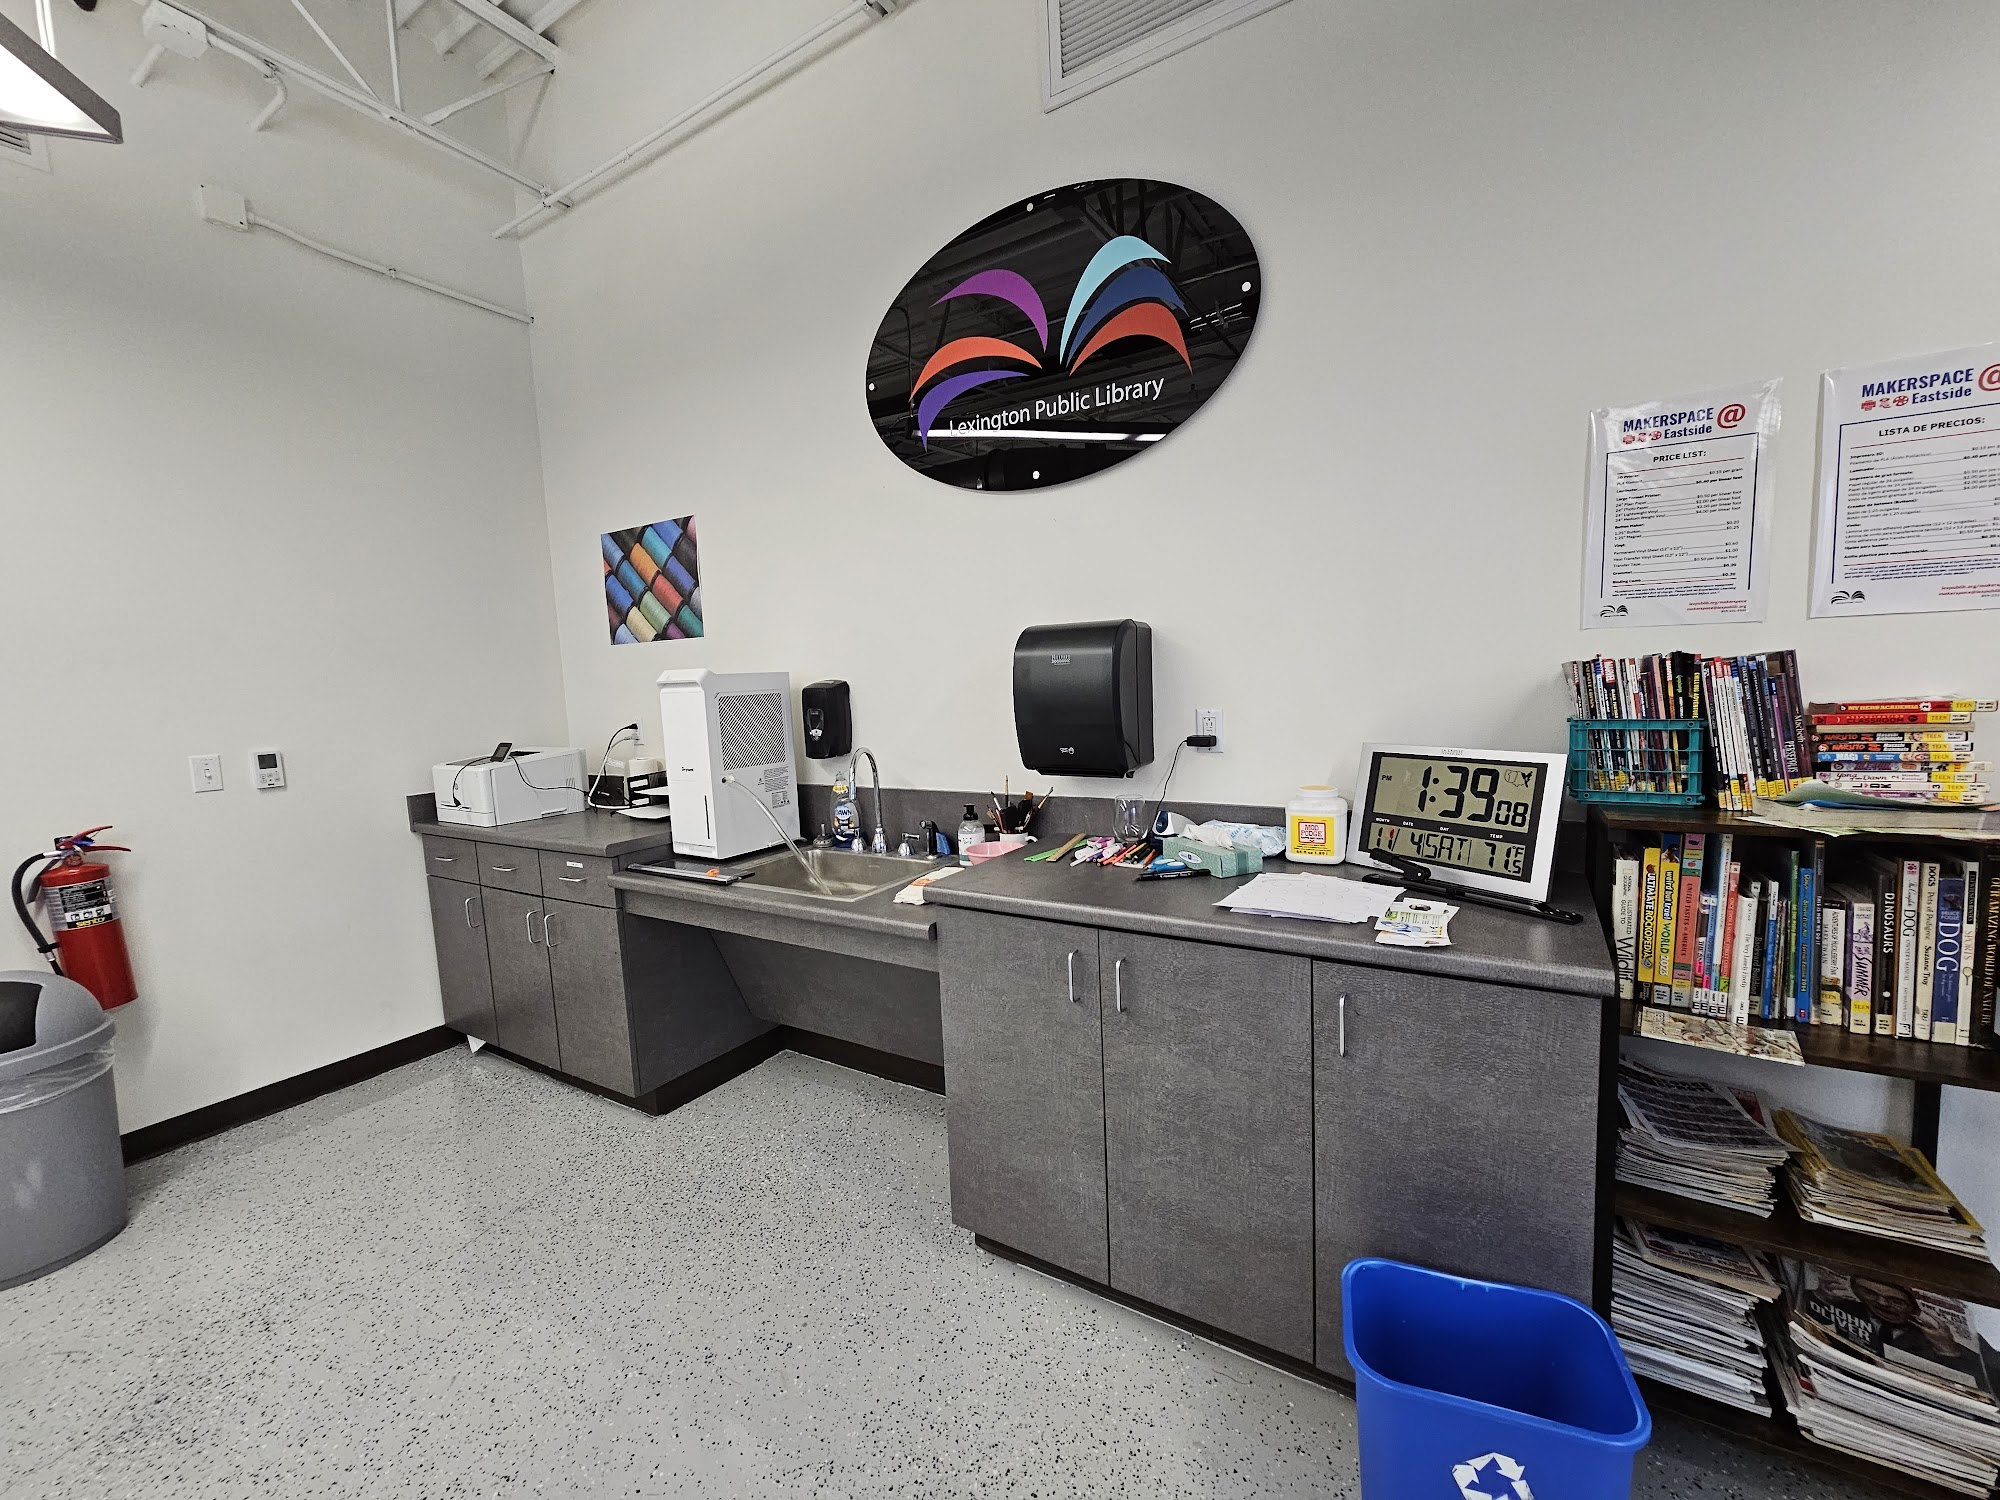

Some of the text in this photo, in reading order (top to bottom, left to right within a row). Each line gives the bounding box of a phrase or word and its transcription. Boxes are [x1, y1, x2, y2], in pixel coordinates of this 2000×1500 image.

[1862, 368, 1974, 397] MAKERSPACE
[1912, 387, 1971, 404] Eastside
[950, 378, 1164, 436] Lexington Public Library
[1624, 404, 1745, 432] MAKERSPACE @
[1664, 424, 1712, 439] Eastside
[1879, 417, 1985, 436] LISTA DE PRECIOS:
[1653, 454, 1680, 462] PRICE
[1794, 714, 1806, 743] Macbeth
[1785, 741, 1798, 773] PERSEPOLIS
[1417, 766, 1500, 822] 1:39
[1495, 801, 1529, 828] 08
[1411, 831, 1423, 855] 4
[1425, 834, 1468, 861] SAT
[1665, 871, 1673, 890] weird
[1928, 866, 1936, 887] DOGS
[1663, 902, 1672, 920] true!
[1927, 891, 1935, 905] Pets
[1643, 873, 1656, 959] ULTIMATE ROCKOPEDIA
[1883, 892, 1895, 953] DINOSAURS
[1902, 909, 1917, 937] DOG
[1924, 914, 1933, 940] Pedigree
[1987, 897, 1999, 942] AMAZING
[1660, 923, 1671, 954] WORLD
[1681, 932, 1689, 956] AMERICA
[1936, 921, 1960, 972] DOG
[1963, 930, 1973, 961] SPORTS
[1617, 937, 1634, 981] Wildlif
[1742, 956, 1750, 971] Lonely
[1924, 945, 1932, 971] Suzanne
[1984, 944, 1996, 976] WORLD
[1750, 968, 1760, 995] Building
[1852, 952, 1872, 997] SUMMER
[1922, 973, 1931, 986] Troy
[1983, 977, 1992, 988] OF
[1981, 990, 1991, 1026] NATURE
[1810, 1301, 1871, 1342] OLIVER
[1823, 1305, 1873, 1333] JOHN
